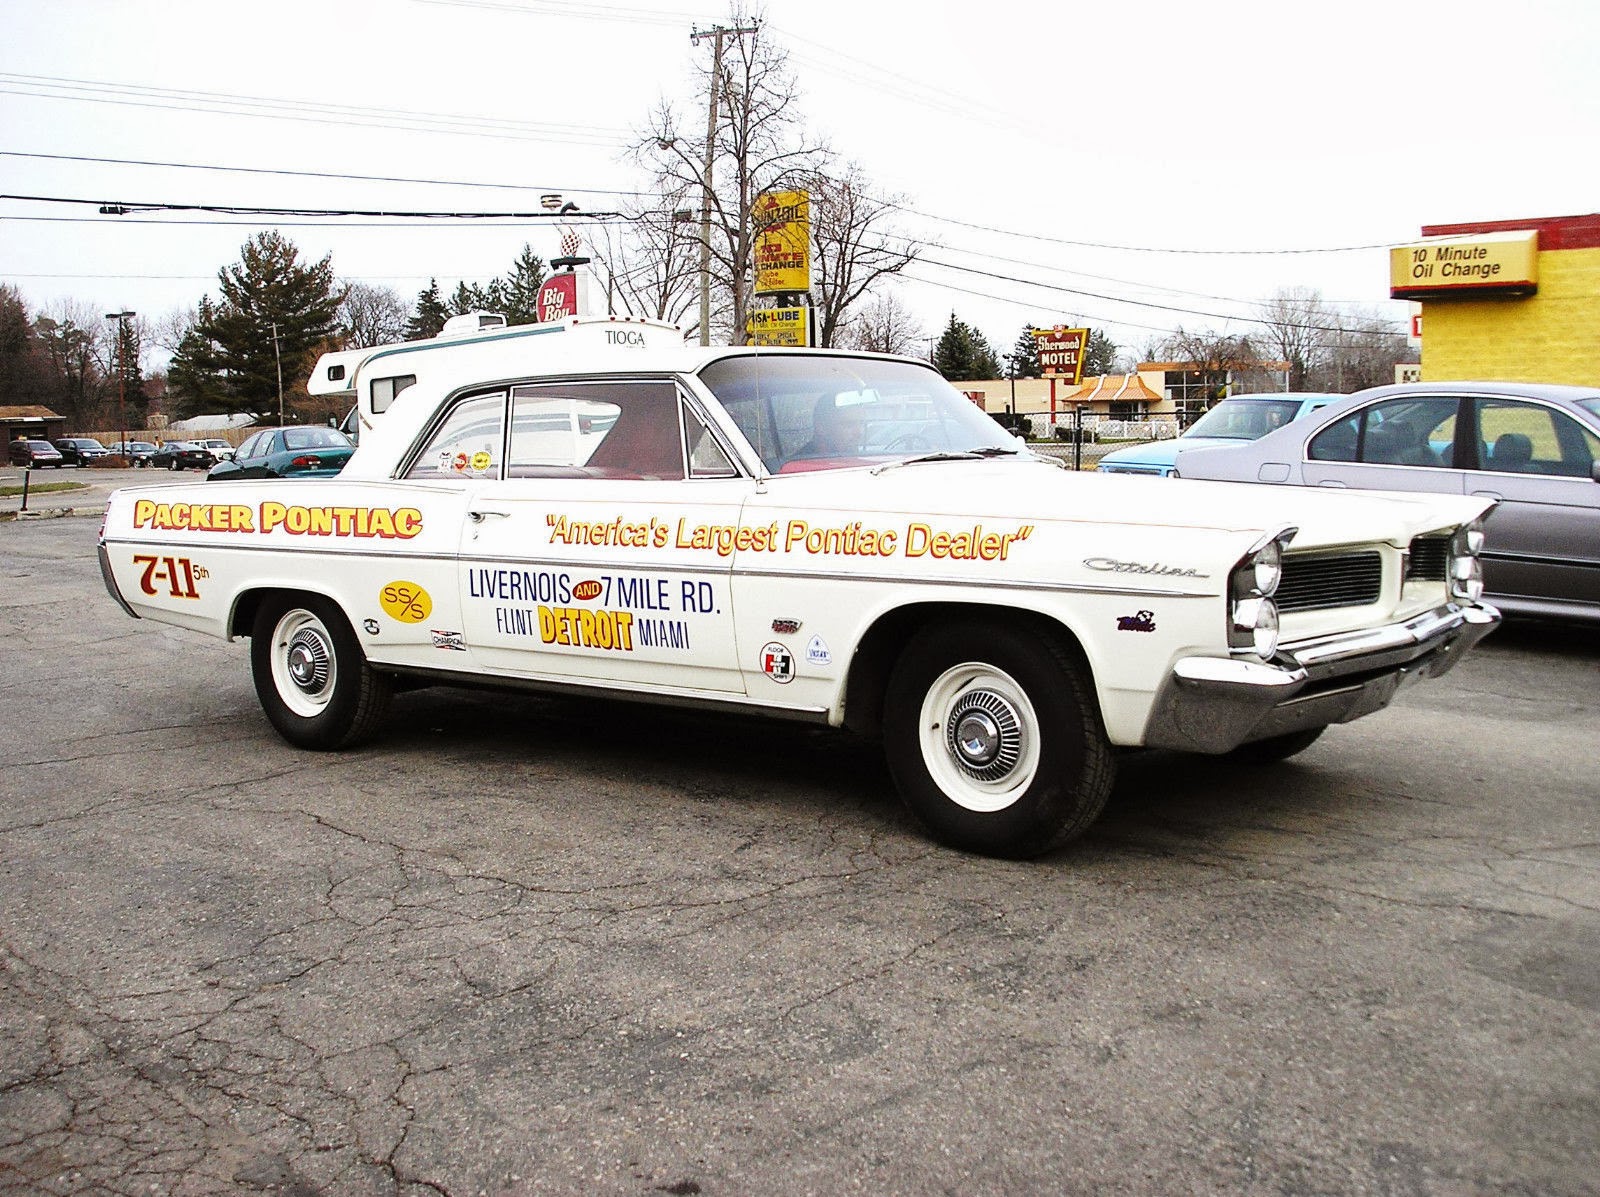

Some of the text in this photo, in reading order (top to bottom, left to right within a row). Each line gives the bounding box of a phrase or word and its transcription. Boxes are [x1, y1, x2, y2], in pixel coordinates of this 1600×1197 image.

[1413, 247, 1487, 262] 10 Minute
[760, 260, 804, 270] CHANGE
[1413, 262, 1500, 278] Oil Change
[543, 288, 564, 307] Big
[605, 330, 645, 345] TIOGA
[1038, 335, 1080, 351] Sherwood
[1041, 352, 1077, 365] MOTEL
[134, 500, 423, 539] PACKER PONTIAC
[676, 517, 779, 556] Largest
[785, 520, 897, 557] Pontiac
[133, 555, 210, 599] 7-11 5th
[1083, 557, 1210, 578] Catalina
[469, 569, 721, 615] LIVERNOIS AND 7 MILE RD.
[384, 587, 425, 620] SS/S
[496, 605, 690, 651] FLINT DETROIT MIAMI
